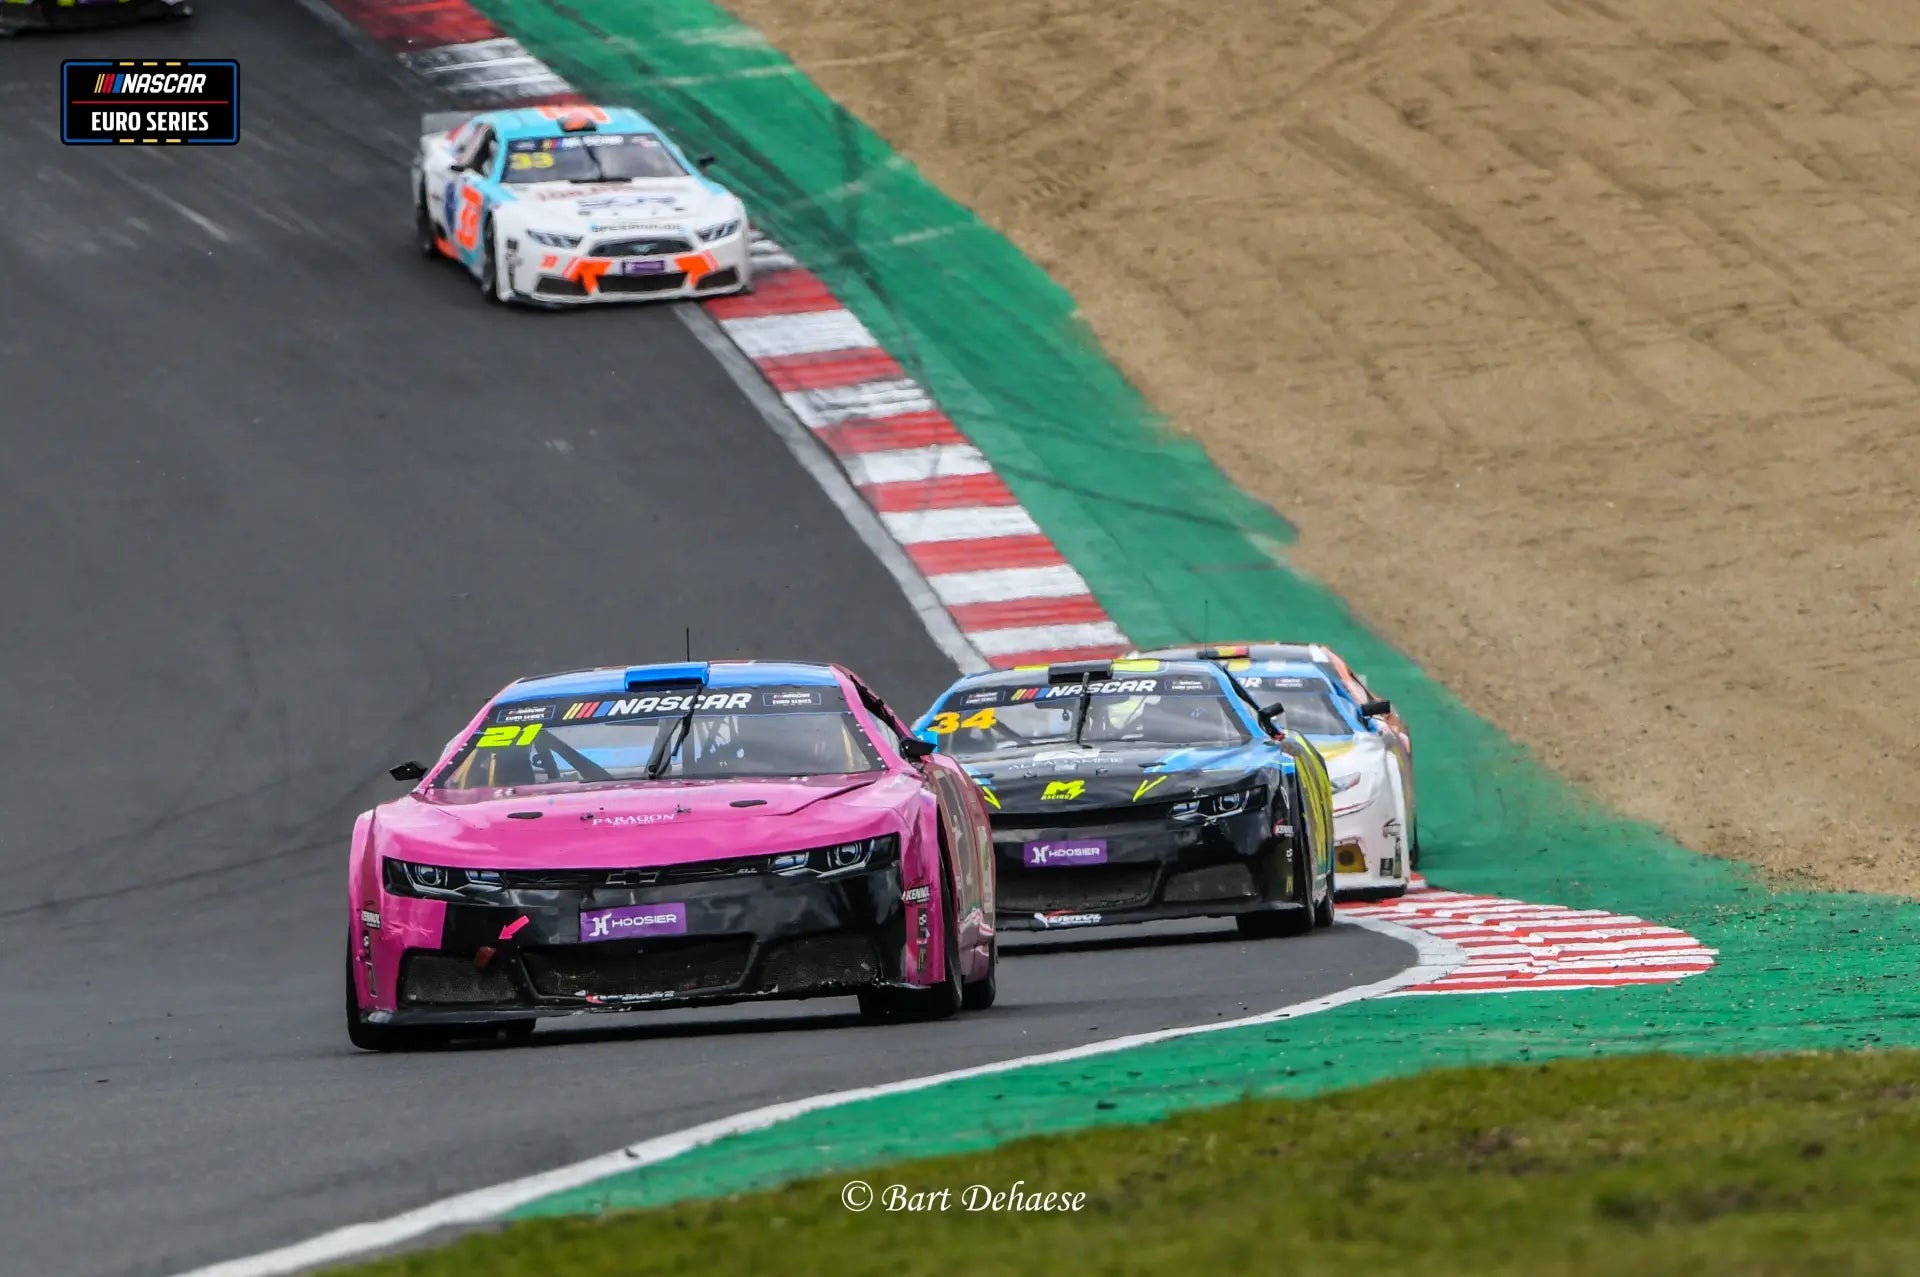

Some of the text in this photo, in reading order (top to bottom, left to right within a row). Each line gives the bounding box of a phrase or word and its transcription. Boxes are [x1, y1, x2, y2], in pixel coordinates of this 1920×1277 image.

[1047, 680, 1157, 698] NASCAR
[607, 692, 752, 716] NASCAR
[927, 707, 997, 734] 34
[476, 723, 543, 747] 21
[592, 814, 675, 826] PARAGON
[1048, 847, 1101, 858] HOOSIER
[612, 914, 678, 928] HOOSIER
